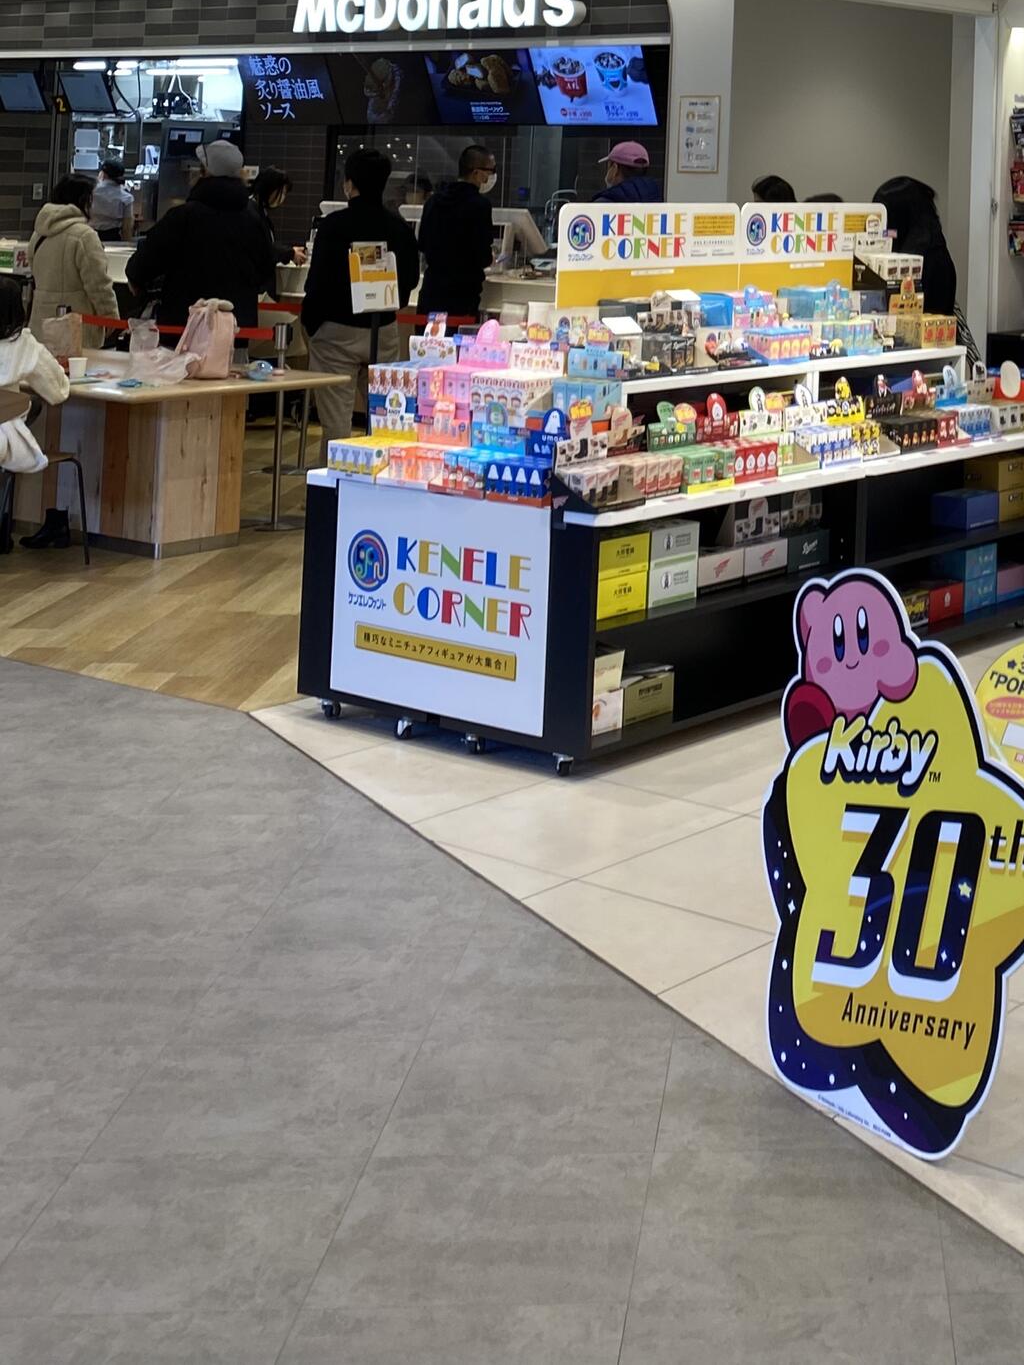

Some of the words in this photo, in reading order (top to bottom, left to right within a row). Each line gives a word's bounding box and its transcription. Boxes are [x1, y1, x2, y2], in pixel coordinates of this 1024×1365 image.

[259, 102, 296, 121] ソース
[602, 212, 688, 237] KENELE
[771, 211, 839, 234] KENELE
[601, 235, 687, 261] CORNER
[770, 233, 838, 255] CORNER
[396, 536, 532, 593] KENELE
[393, 581, 532, 641] CORNER
[820, 712, 939, 798] Kirby
[841, 991, 977, 1051] Anniversary
